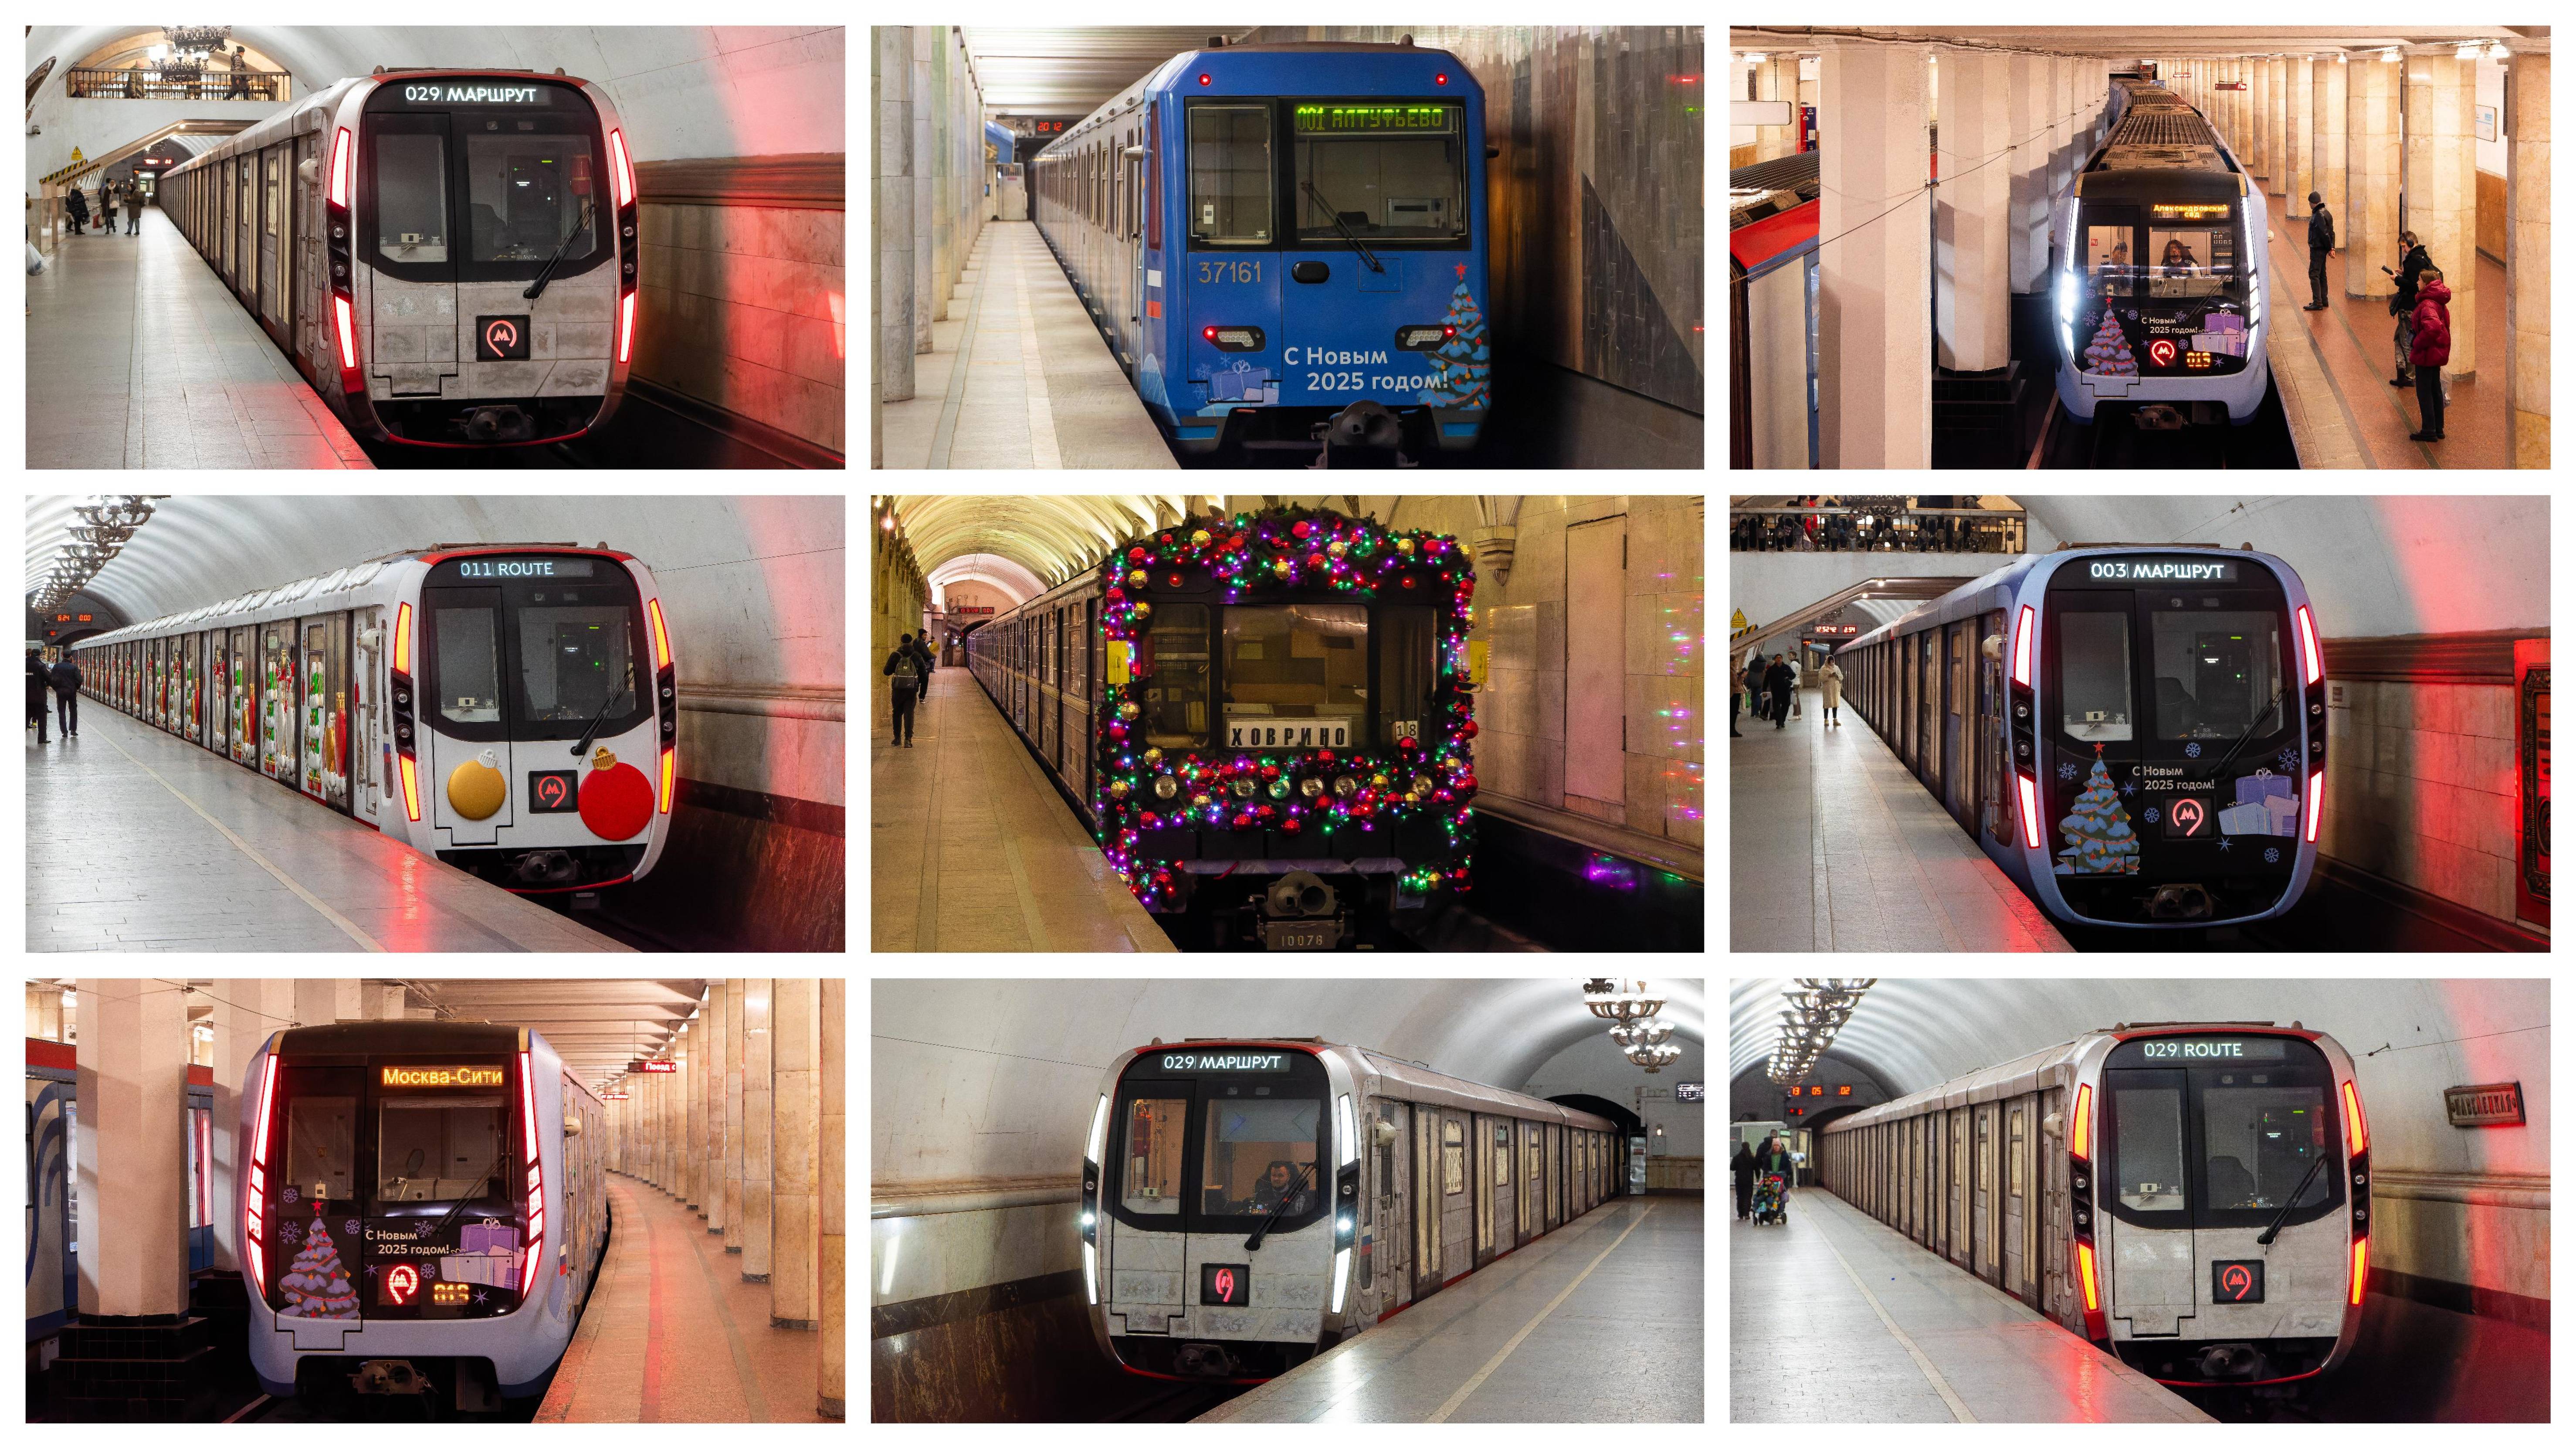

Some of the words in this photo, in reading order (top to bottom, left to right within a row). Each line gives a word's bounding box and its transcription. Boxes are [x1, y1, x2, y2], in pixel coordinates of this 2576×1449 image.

[406, 86, 440, 101] 029
[447, 87, 536, 102] МАРШРУТ
[1298, 108, 1325, 130] 001
[1332, 109, 1442, 128] АЛТУФЬЕВО
[1198, 261, 1261, 284] 37161
[1285, 347, 1298, 366] С
[1307, 347, 1388, 365] Новым
[1307, 372, 1364, 390] 2025
[1372, 371, 1448, 392] годом!
[461, 563, 491, 576] 011
[498, 563, 553, 576] ROUTE
[2091, 563, 2126, 577] 003
[2133, 564, 2224, 579] МАРШРУТ
[1231, 727, 1345, 746] ХОВРИНО
[2143, 766, 2183, 776] Новым
[2145, 780, 2173, 790] 2025
[2177, 779, 2214, 791] годом!
[1282, 935, 1322, 947] 10078
[2144, 1043, 2177, 1057] 029
[2185, 1043, 2243, 1057] ROUTE
[646, 1062, 670, 1072] Поезд
[1164, 1055, 1194, 1069] 029
[1200, 1055, 1281, 1069] МАРШРУТ
[383, 1068, 503, 1086] Москва-Сити
[377, 1230, 417, 1240] Новым
[378, 1244, 407, 1254] 2025
[411, 1244, 449, 1255] годом!
